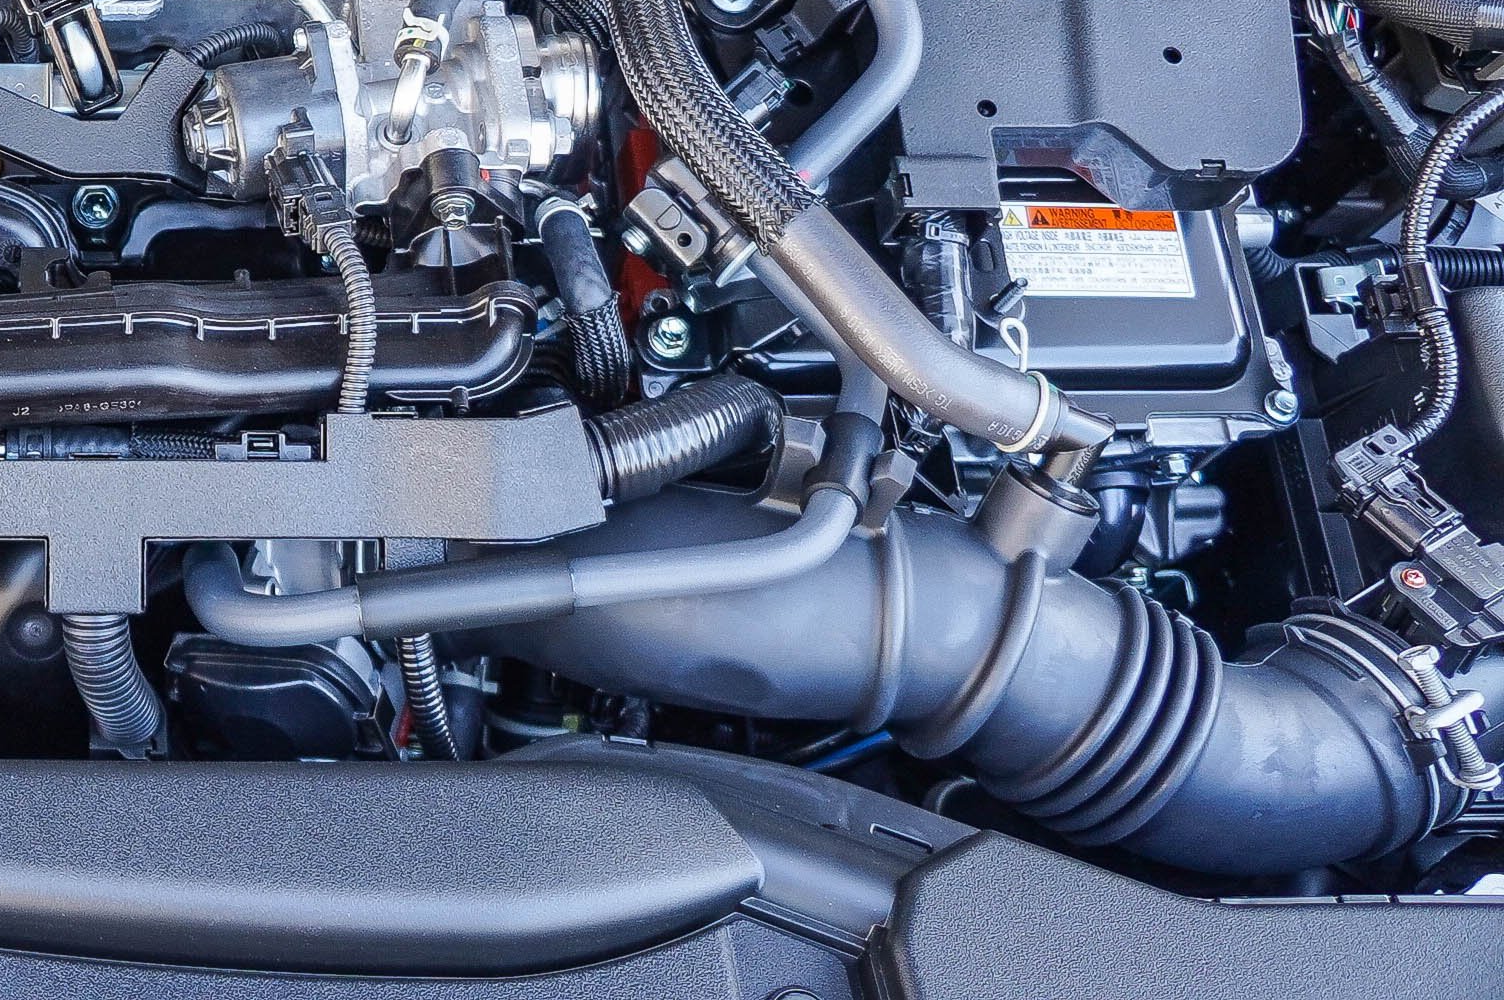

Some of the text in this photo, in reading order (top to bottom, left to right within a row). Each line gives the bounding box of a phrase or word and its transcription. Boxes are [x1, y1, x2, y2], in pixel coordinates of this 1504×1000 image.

[1049, 208, 1096, 219] WARNING
[933, 391, 954, 411] TG
[12, 405, 31, 417] J2
